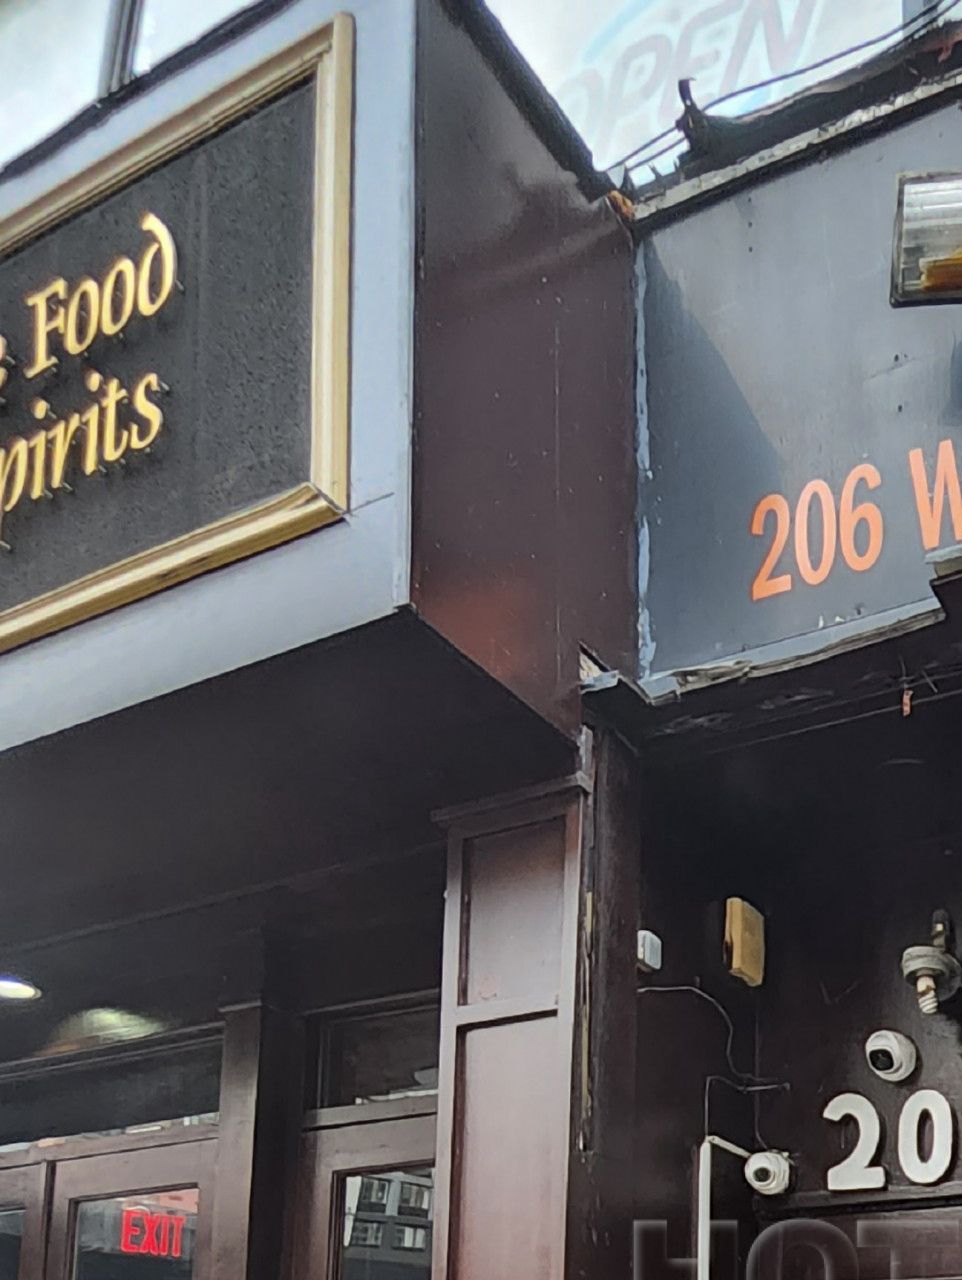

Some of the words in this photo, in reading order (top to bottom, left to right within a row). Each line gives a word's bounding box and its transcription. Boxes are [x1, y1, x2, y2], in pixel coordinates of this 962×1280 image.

[24, 212, 176, 379] Food
[751, 463, 884, 601] 206
[120, 1208, 187, 1258] EXIT
